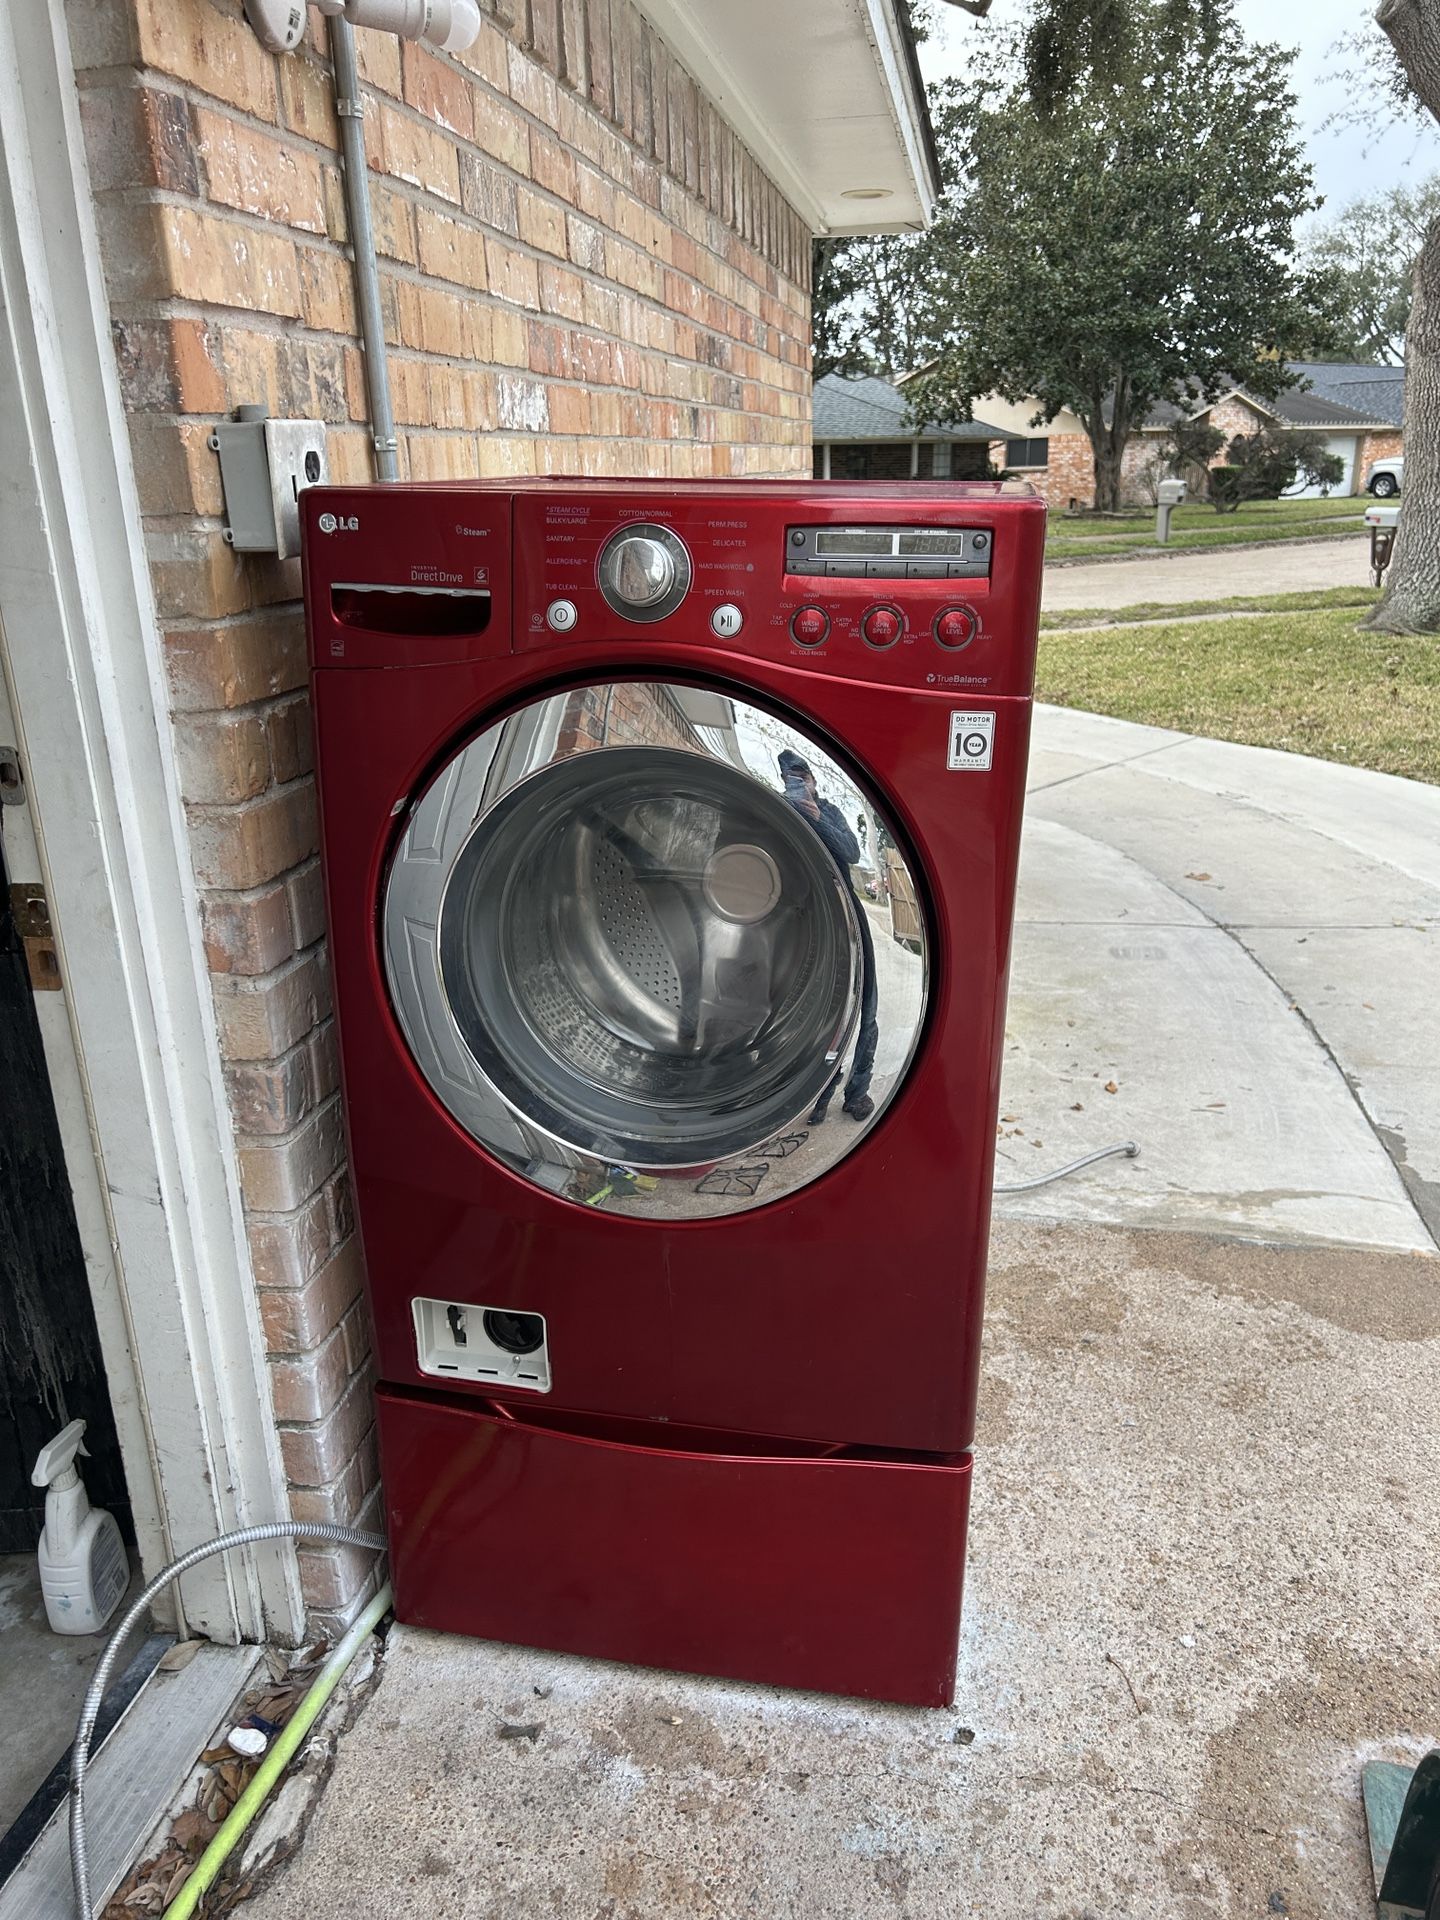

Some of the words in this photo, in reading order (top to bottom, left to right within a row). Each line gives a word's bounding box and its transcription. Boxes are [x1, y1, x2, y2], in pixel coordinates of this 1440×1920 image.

[571, 506, 590, 514] CYCLE
[618, 509, 673, 517] COTTON/NORMAL
[339, 517, 359, 531] LG
[546, 517, 587, 525] BULKY/LARGE
[712, 539, 747, 547] DELICATES
[411, 570, 439, 582] Direct
[439, 571, 463, 583] Drive
[545, 583, 558, 591] TUB
[704, 589, 724, 597] SPEED
[955, 732, 988, 757] 10
